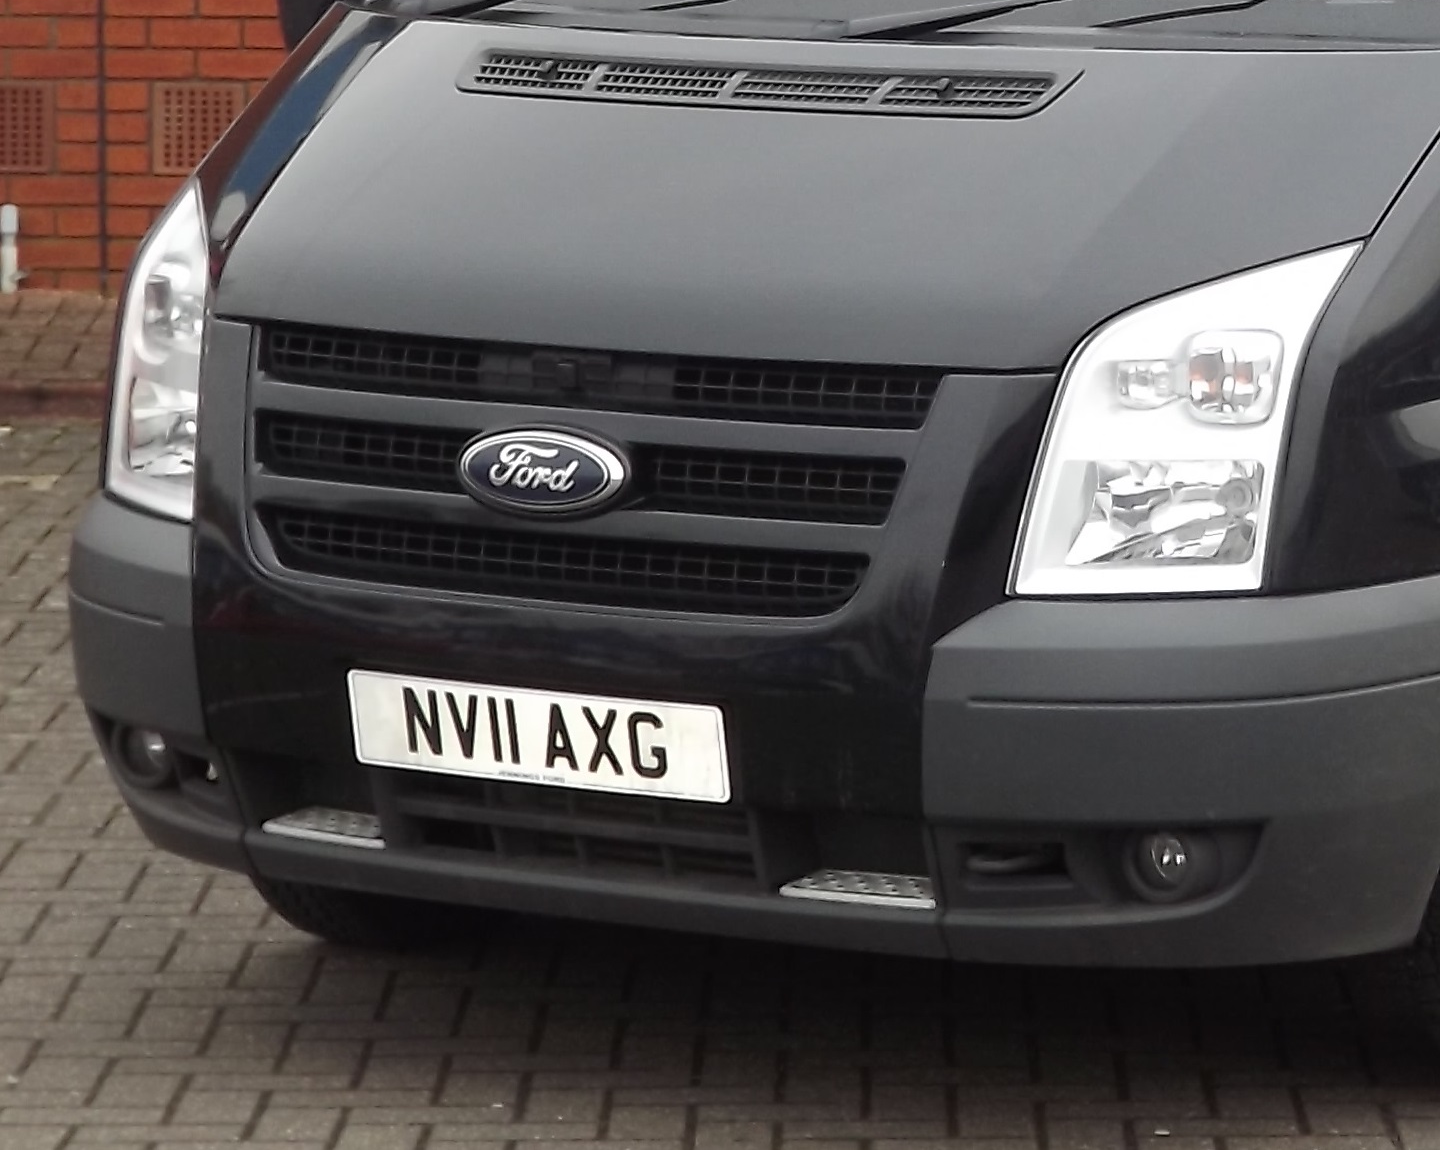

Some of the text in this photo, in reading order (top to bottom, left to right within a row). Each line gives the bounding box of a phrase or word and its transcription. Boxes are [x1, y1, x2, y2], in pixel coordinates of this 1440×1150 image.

[489, 443, 580, 492] Ford
[402, 686, 669, 780] NV11 AXG
